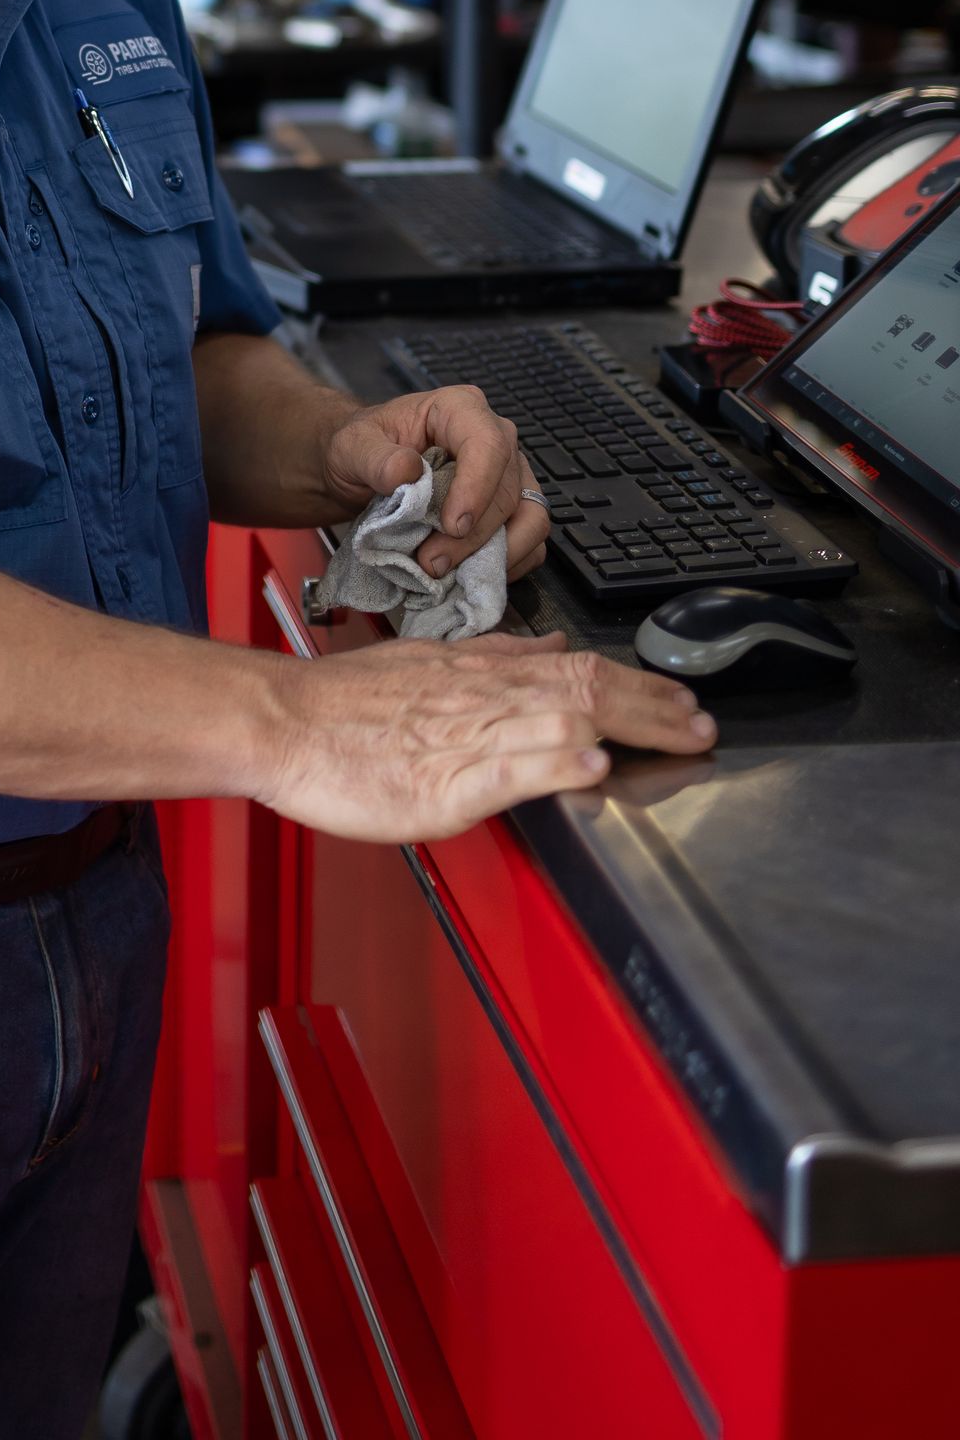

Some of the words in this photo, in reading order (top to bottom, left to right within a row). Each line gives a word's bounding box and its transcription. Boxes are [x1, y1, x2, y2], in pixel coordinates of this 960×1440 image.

[115, 64, 135, 76] TIRE
[133, 62, 141, 72] &
[140, 58, 159, 70] AUTO
